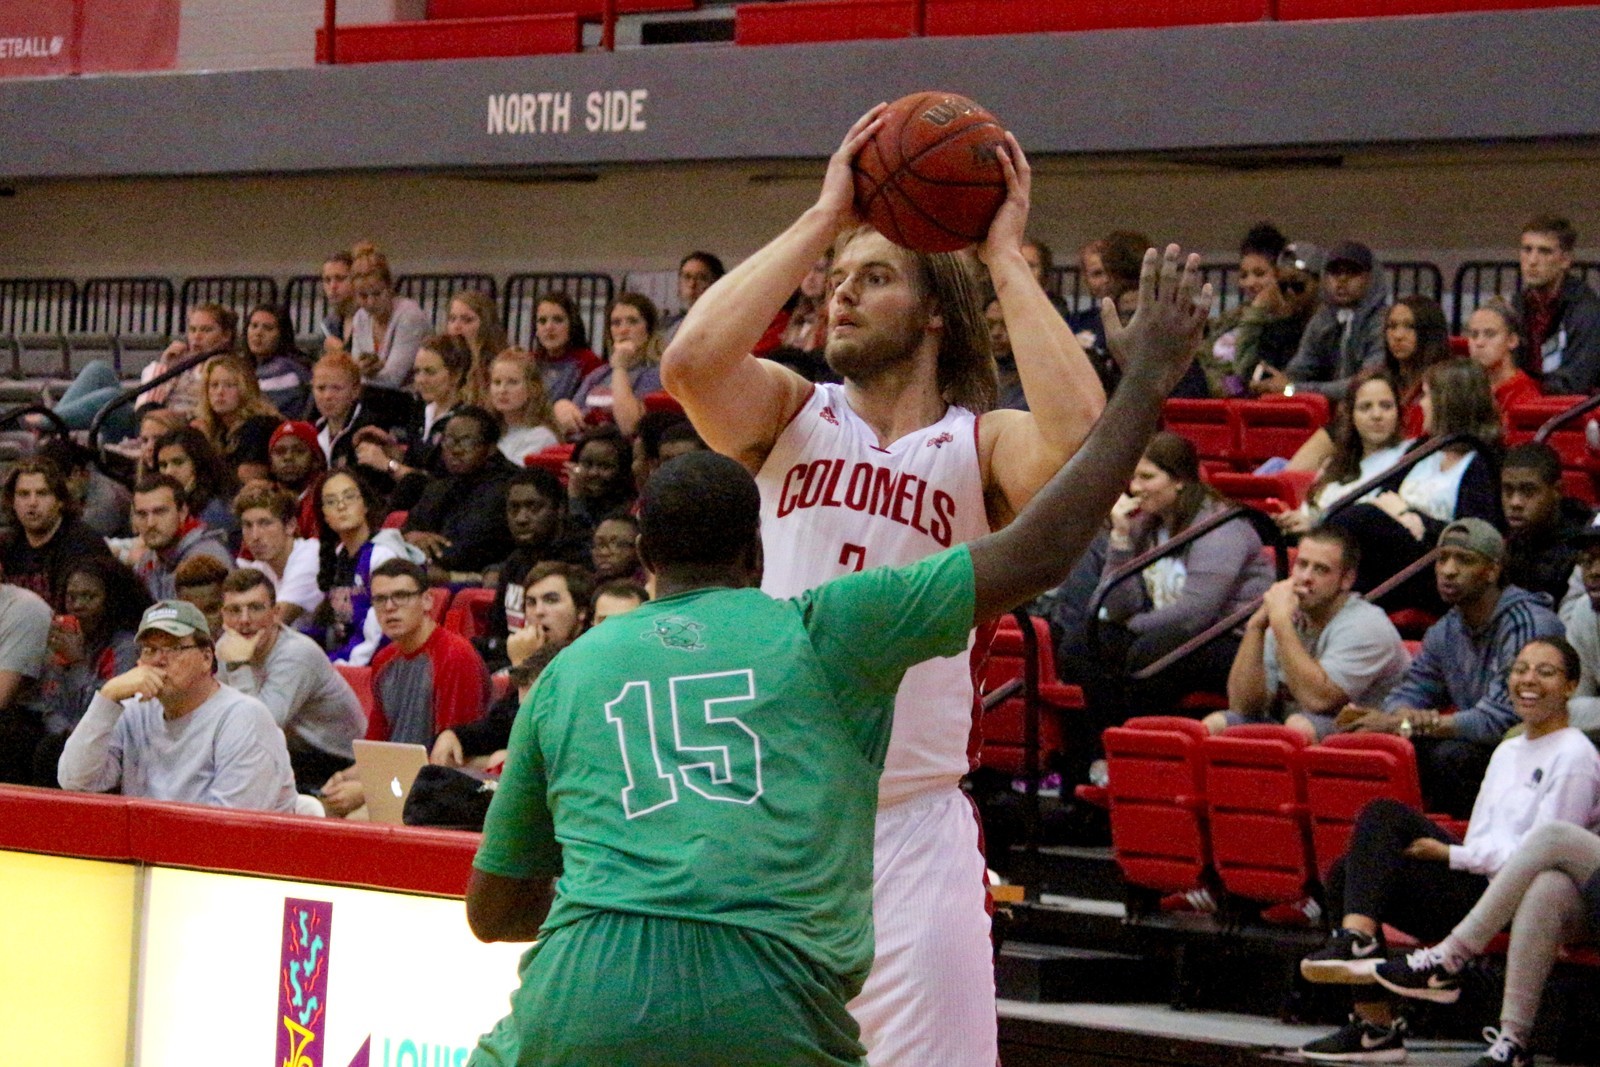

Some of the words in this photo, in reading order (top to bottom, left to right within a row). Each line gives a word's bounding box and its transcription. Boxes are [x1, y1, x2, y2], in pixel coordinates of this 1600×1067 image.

[486, 91, 573, 135] NORTH
[584, 88, 649, 132] SIDE
[776, 458, 956, 548] COLONELS
[604, 668, 764, 820] 15
